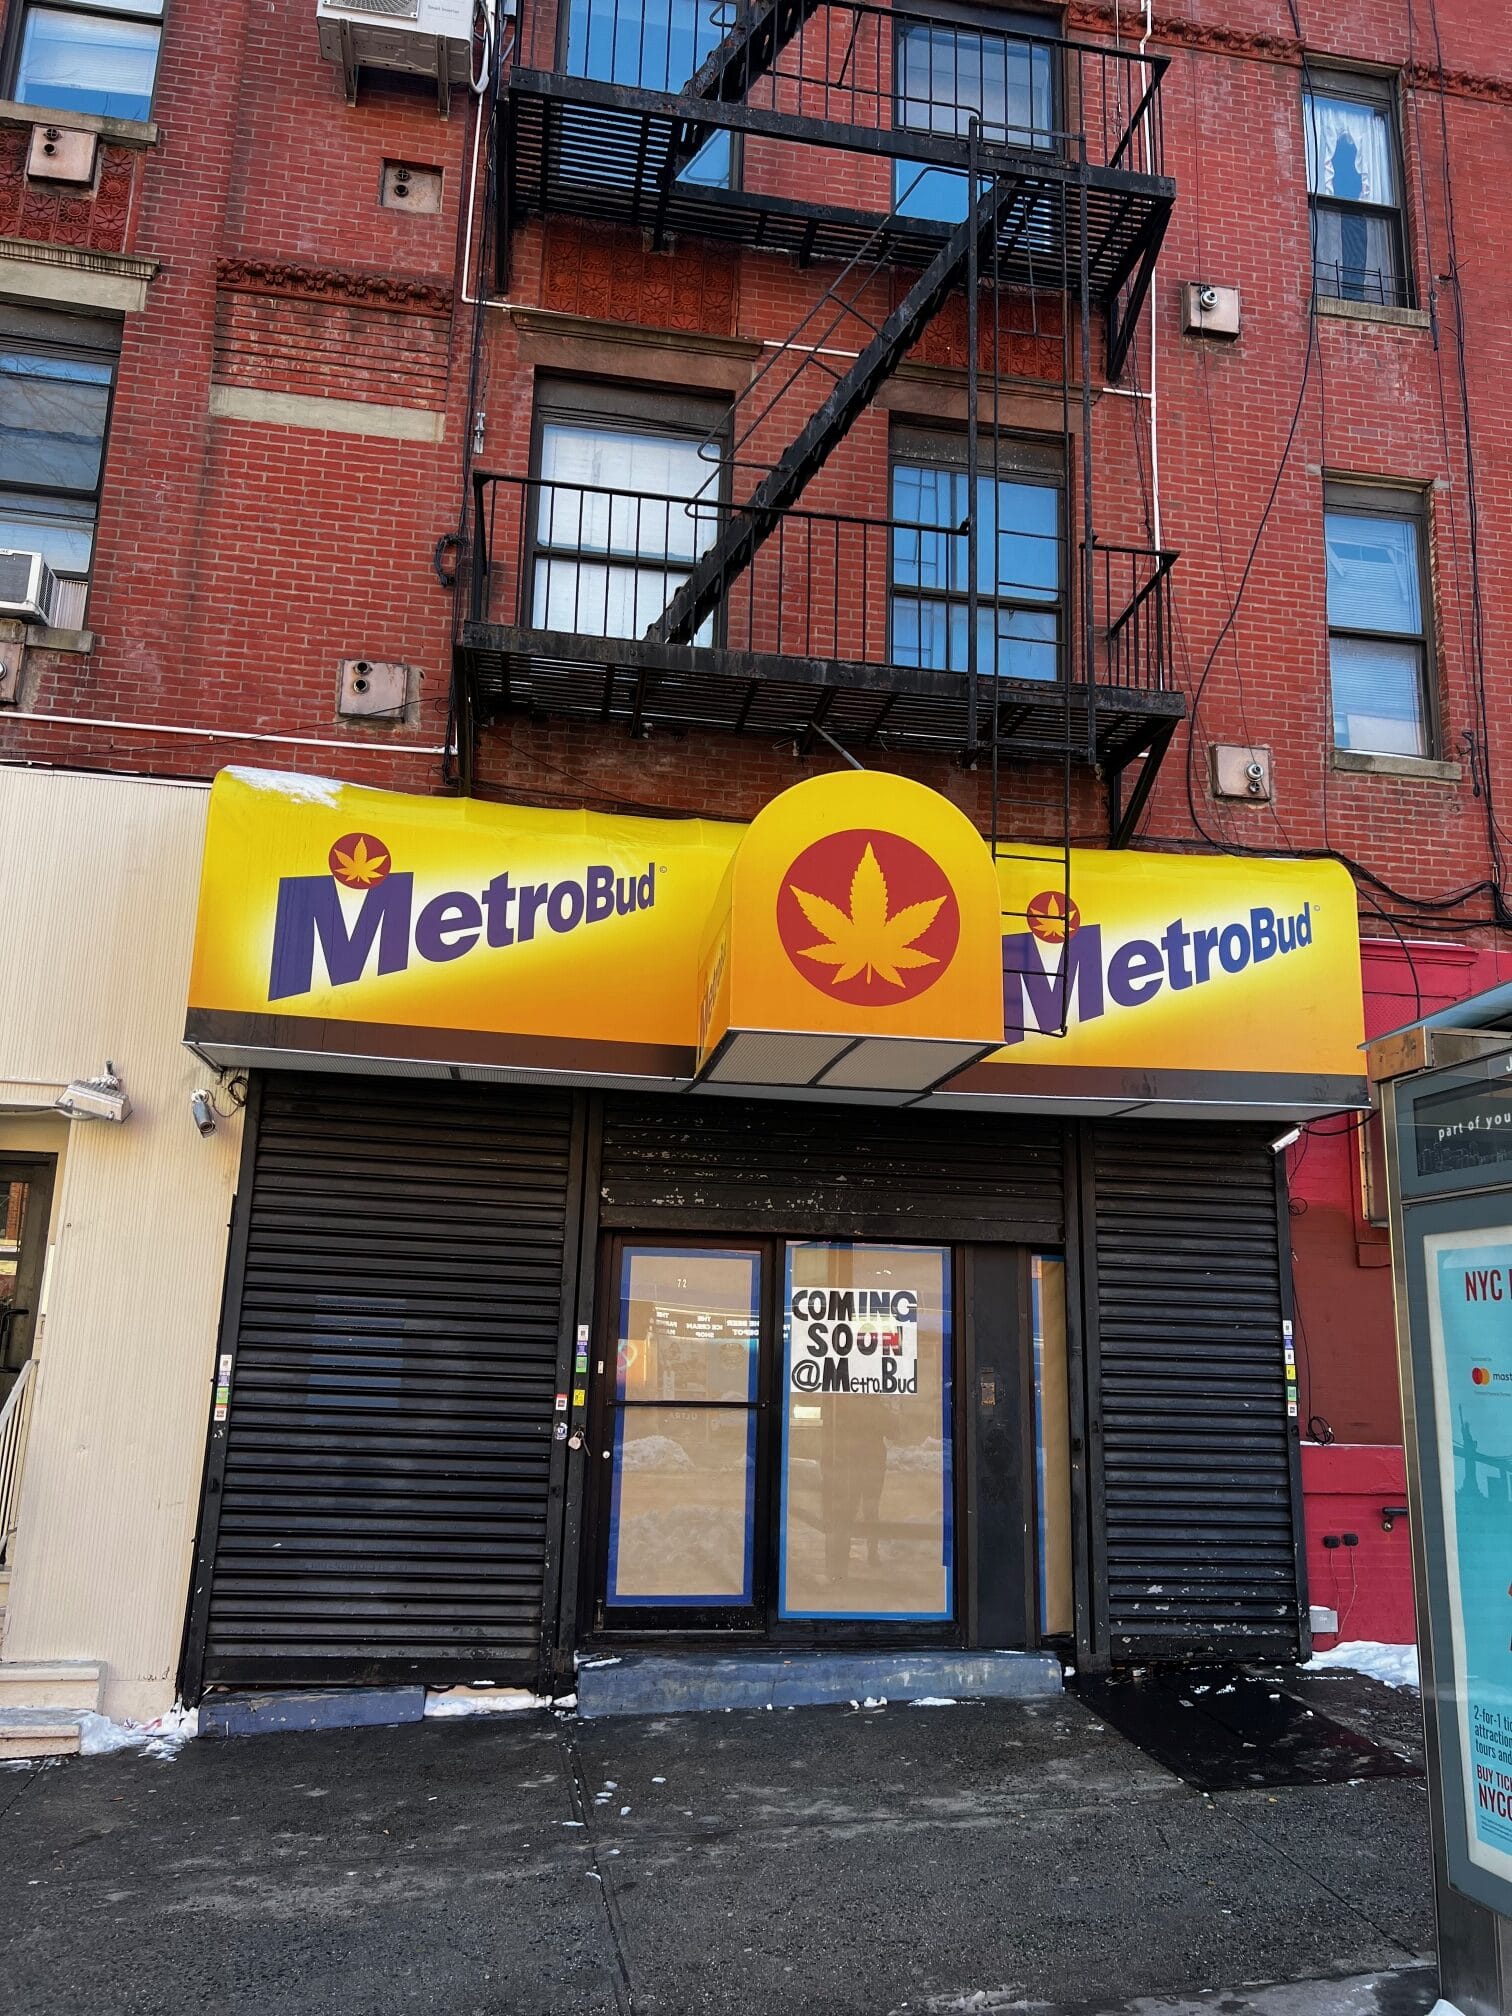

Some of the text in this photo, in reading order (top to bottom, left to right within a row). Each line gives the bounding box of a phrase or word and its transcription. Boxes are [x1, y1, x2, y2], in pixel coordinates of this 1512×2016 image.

[267, 862, 655, 1002] MetroBud
[1002, 901, 1313, 1045] MetroBud
[1438, 1122, 1464, 1142] part
[1467, 1115, 1480, 1131] of
[677, 1278, 687, 1288] 72
[1465, 1269, 1503, 1302] NYC
[791, 1289, 917, 1322] COMING
[807, 1322, 903, 1357] SOON
[1473, 1704, 1501, 1728] 2-for-1
[1475, 1738, 1512, 1765] tours and
[1476, 1763, 1493, 1784] BUY
